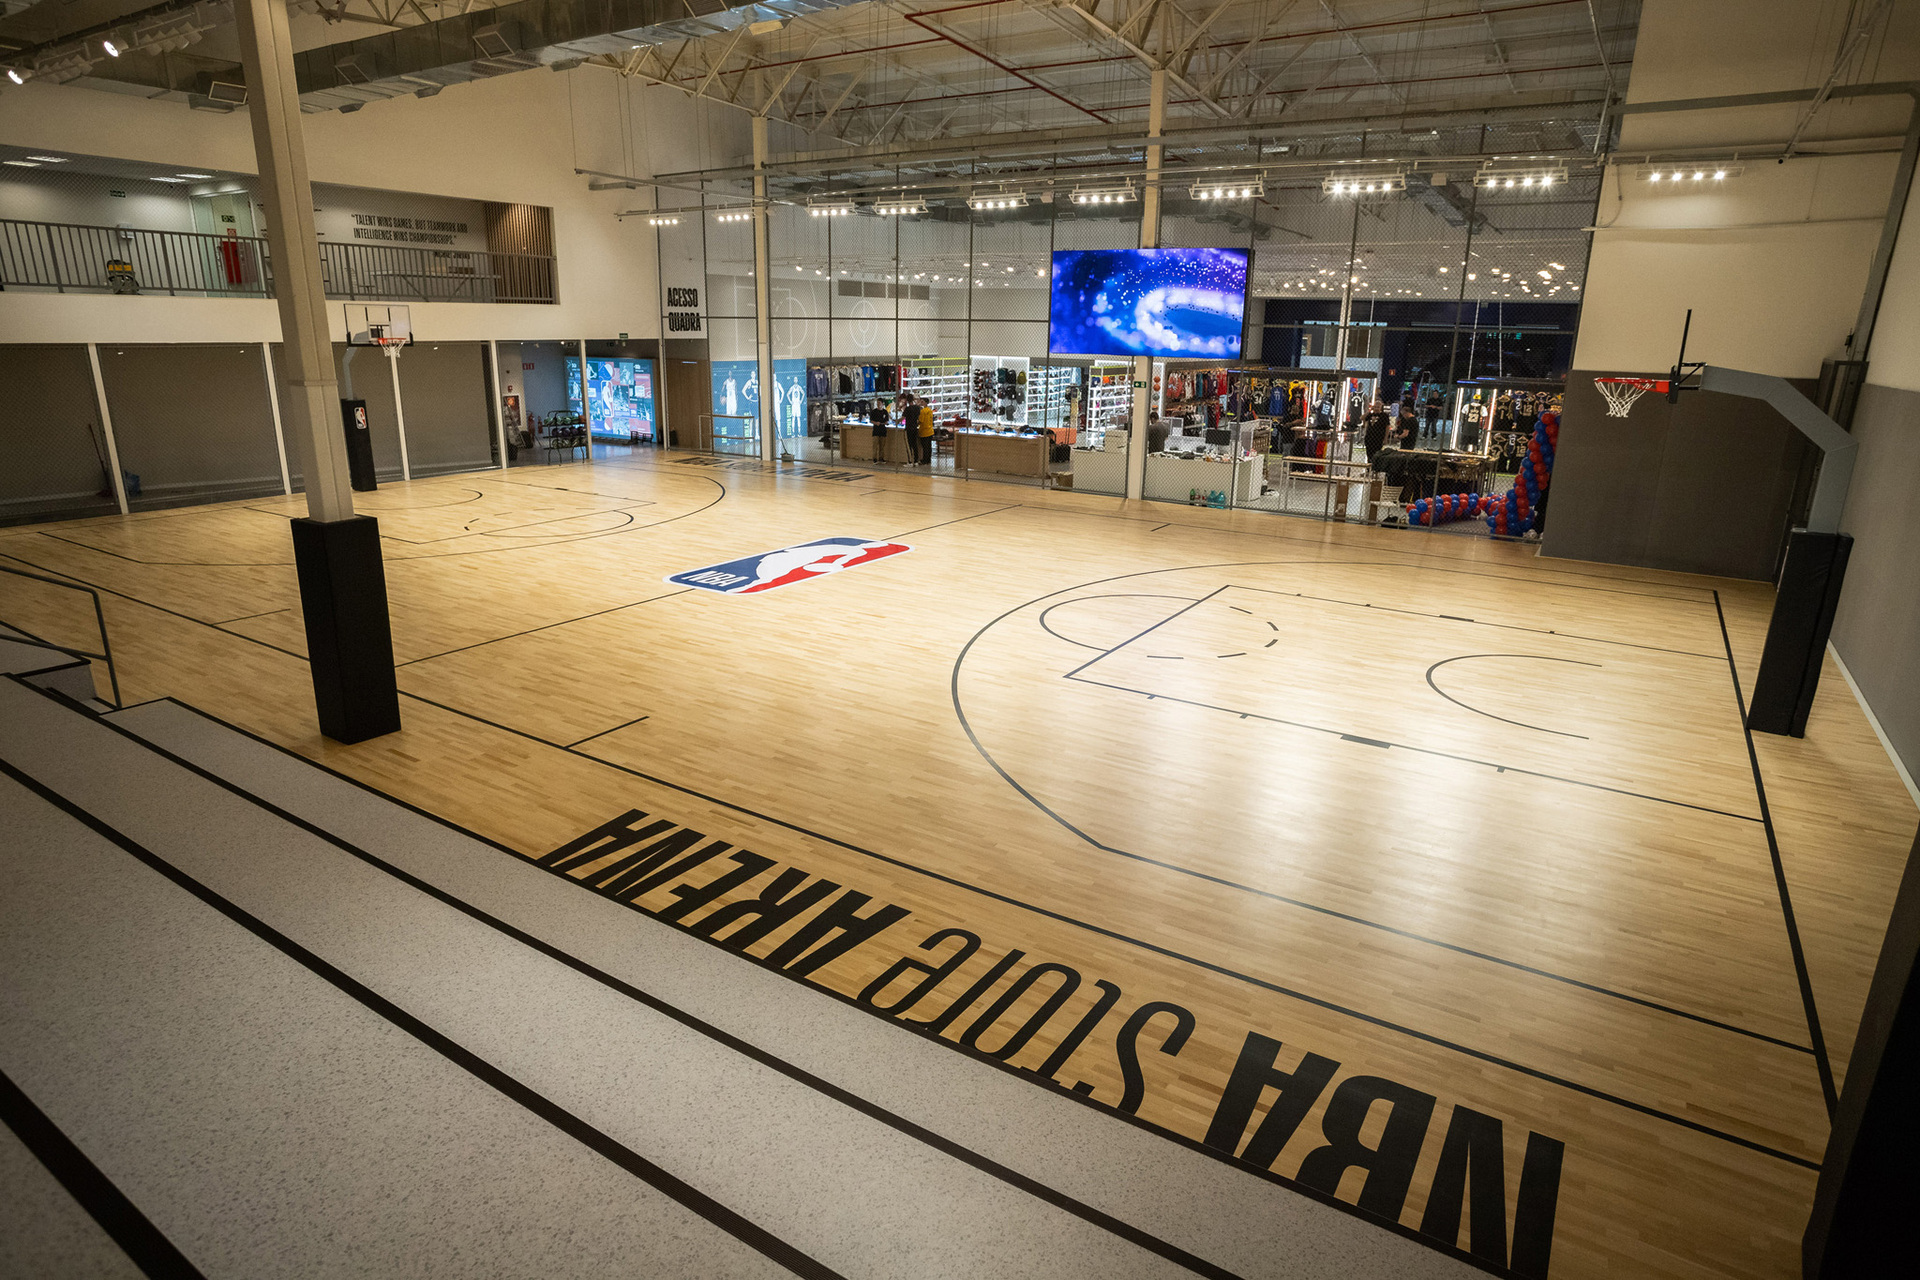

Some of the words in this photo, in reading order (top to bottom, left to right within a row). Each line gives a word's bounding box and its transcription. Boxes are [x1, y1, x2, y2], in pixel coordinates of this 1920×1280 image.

[353, 228, 392, 240] INTELLIGENCE
[392, 230, 409, 241] WINS
[667, 287, 698, 307] ACESSO
[668, 312, 701, 332] QUADRA
[681, 570, 749, 587] NBA
[535, 808, 912, 978] ARENA
[1203, 1031, 1565, 1280] NBA
